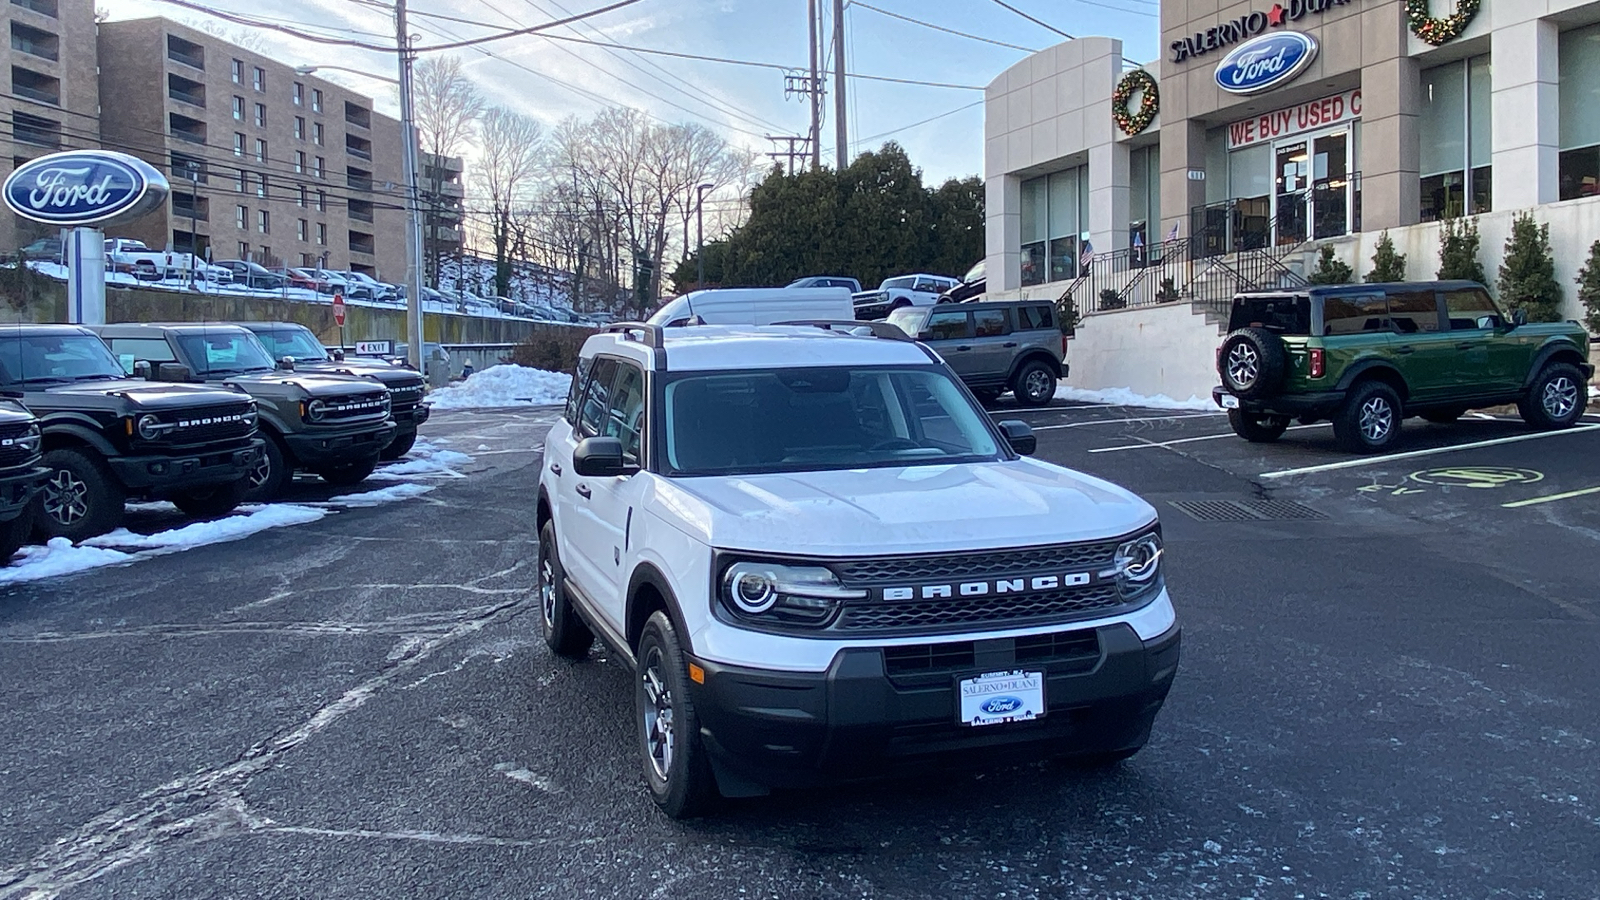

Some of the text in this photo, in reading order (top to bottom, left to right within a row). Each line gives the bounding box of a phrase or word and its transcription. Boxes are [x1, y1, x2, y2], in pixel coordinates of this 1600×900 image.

[1169, 11, 1268, 63] SALERNO
[1232, 45, 1286, 85] Ford
[1230, 120, 1254, 146] WE
[1259, 109, 1292, 139] BUY
[1298, 95, 1344, 129] USED
[29, 167, 113, 209] Ford
[367, 343, 386, 352] EXIT
[338, 401, 381, 411] BRONCO
[179, 414, 241, 427] BRONCO
[883, 572, 1091, 601] BRONCO
[963, 679, 1039, 695] SALERNO DUANE
[988, 698, 1015, 712] Ford
